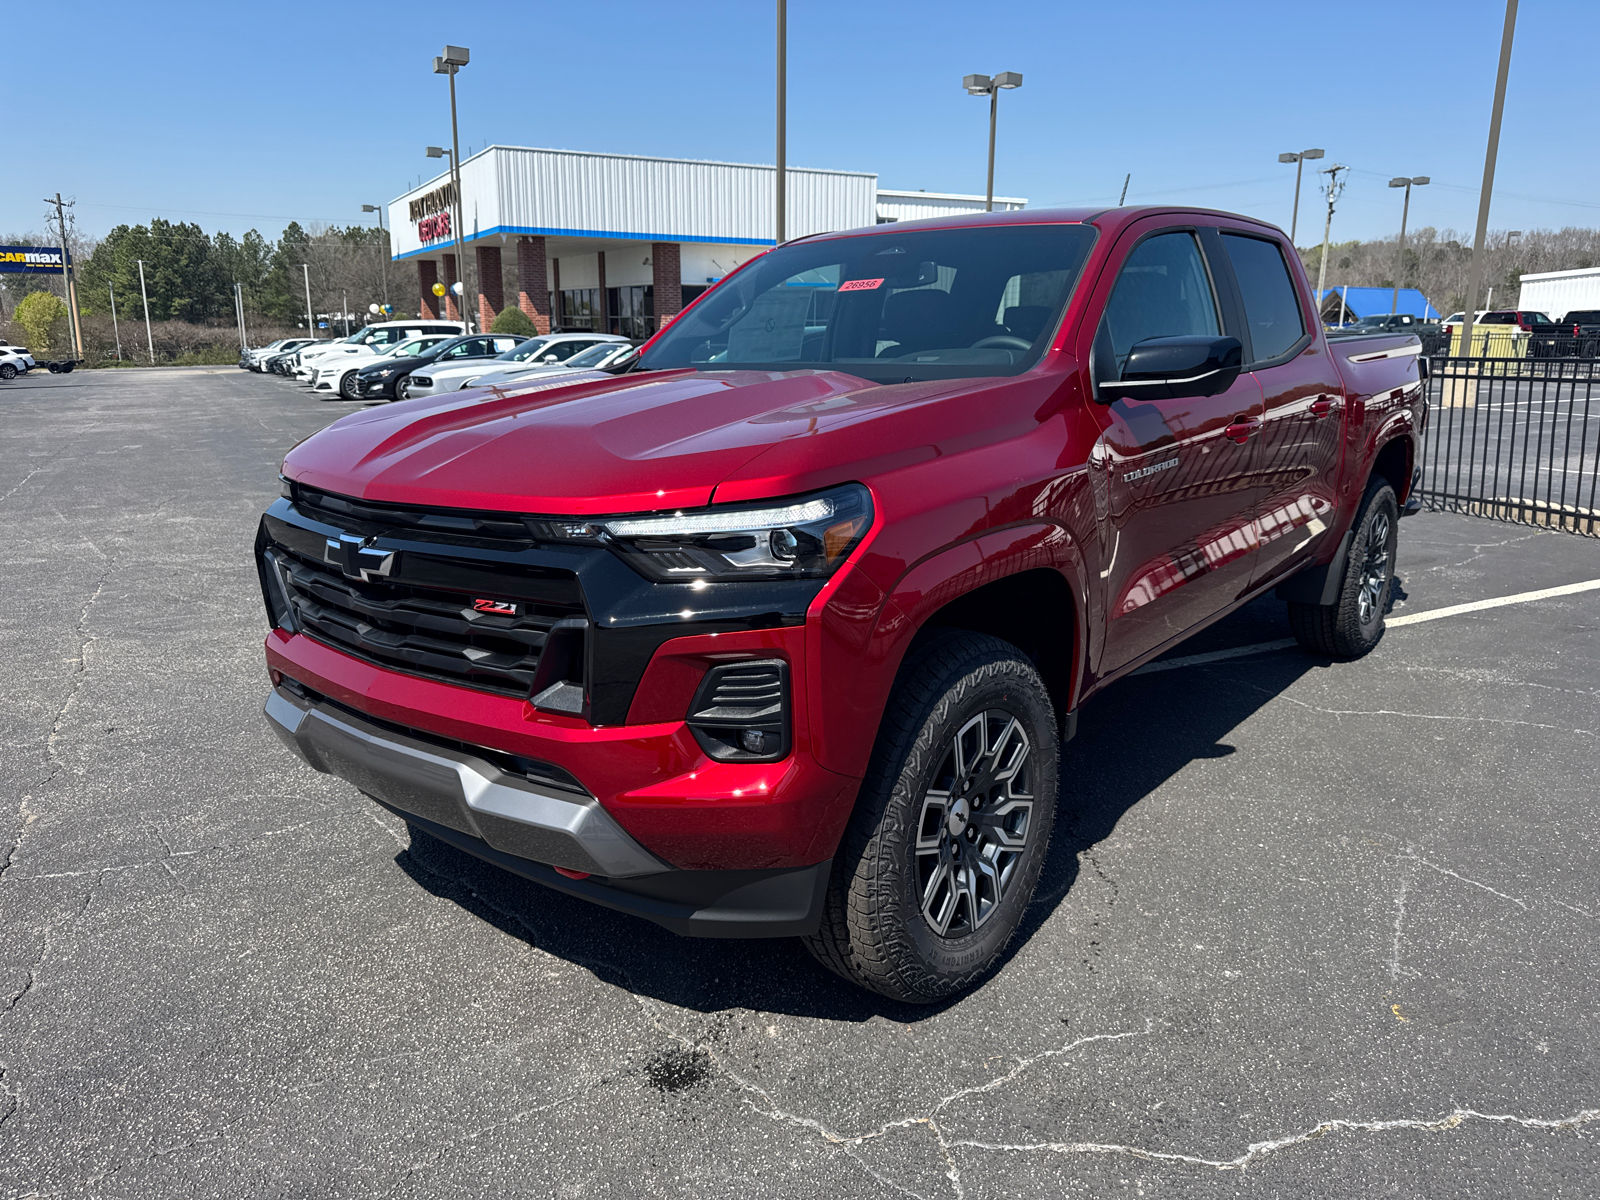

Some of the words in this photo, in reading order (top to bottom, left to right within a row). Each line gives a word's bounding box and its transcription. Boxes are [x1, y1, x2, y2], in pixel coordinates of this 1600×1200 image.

[845, 280, 878, 289] 26956
[1123, 457, 1179, 482] COLORADO
[473, 599, 517, 614] Z71
